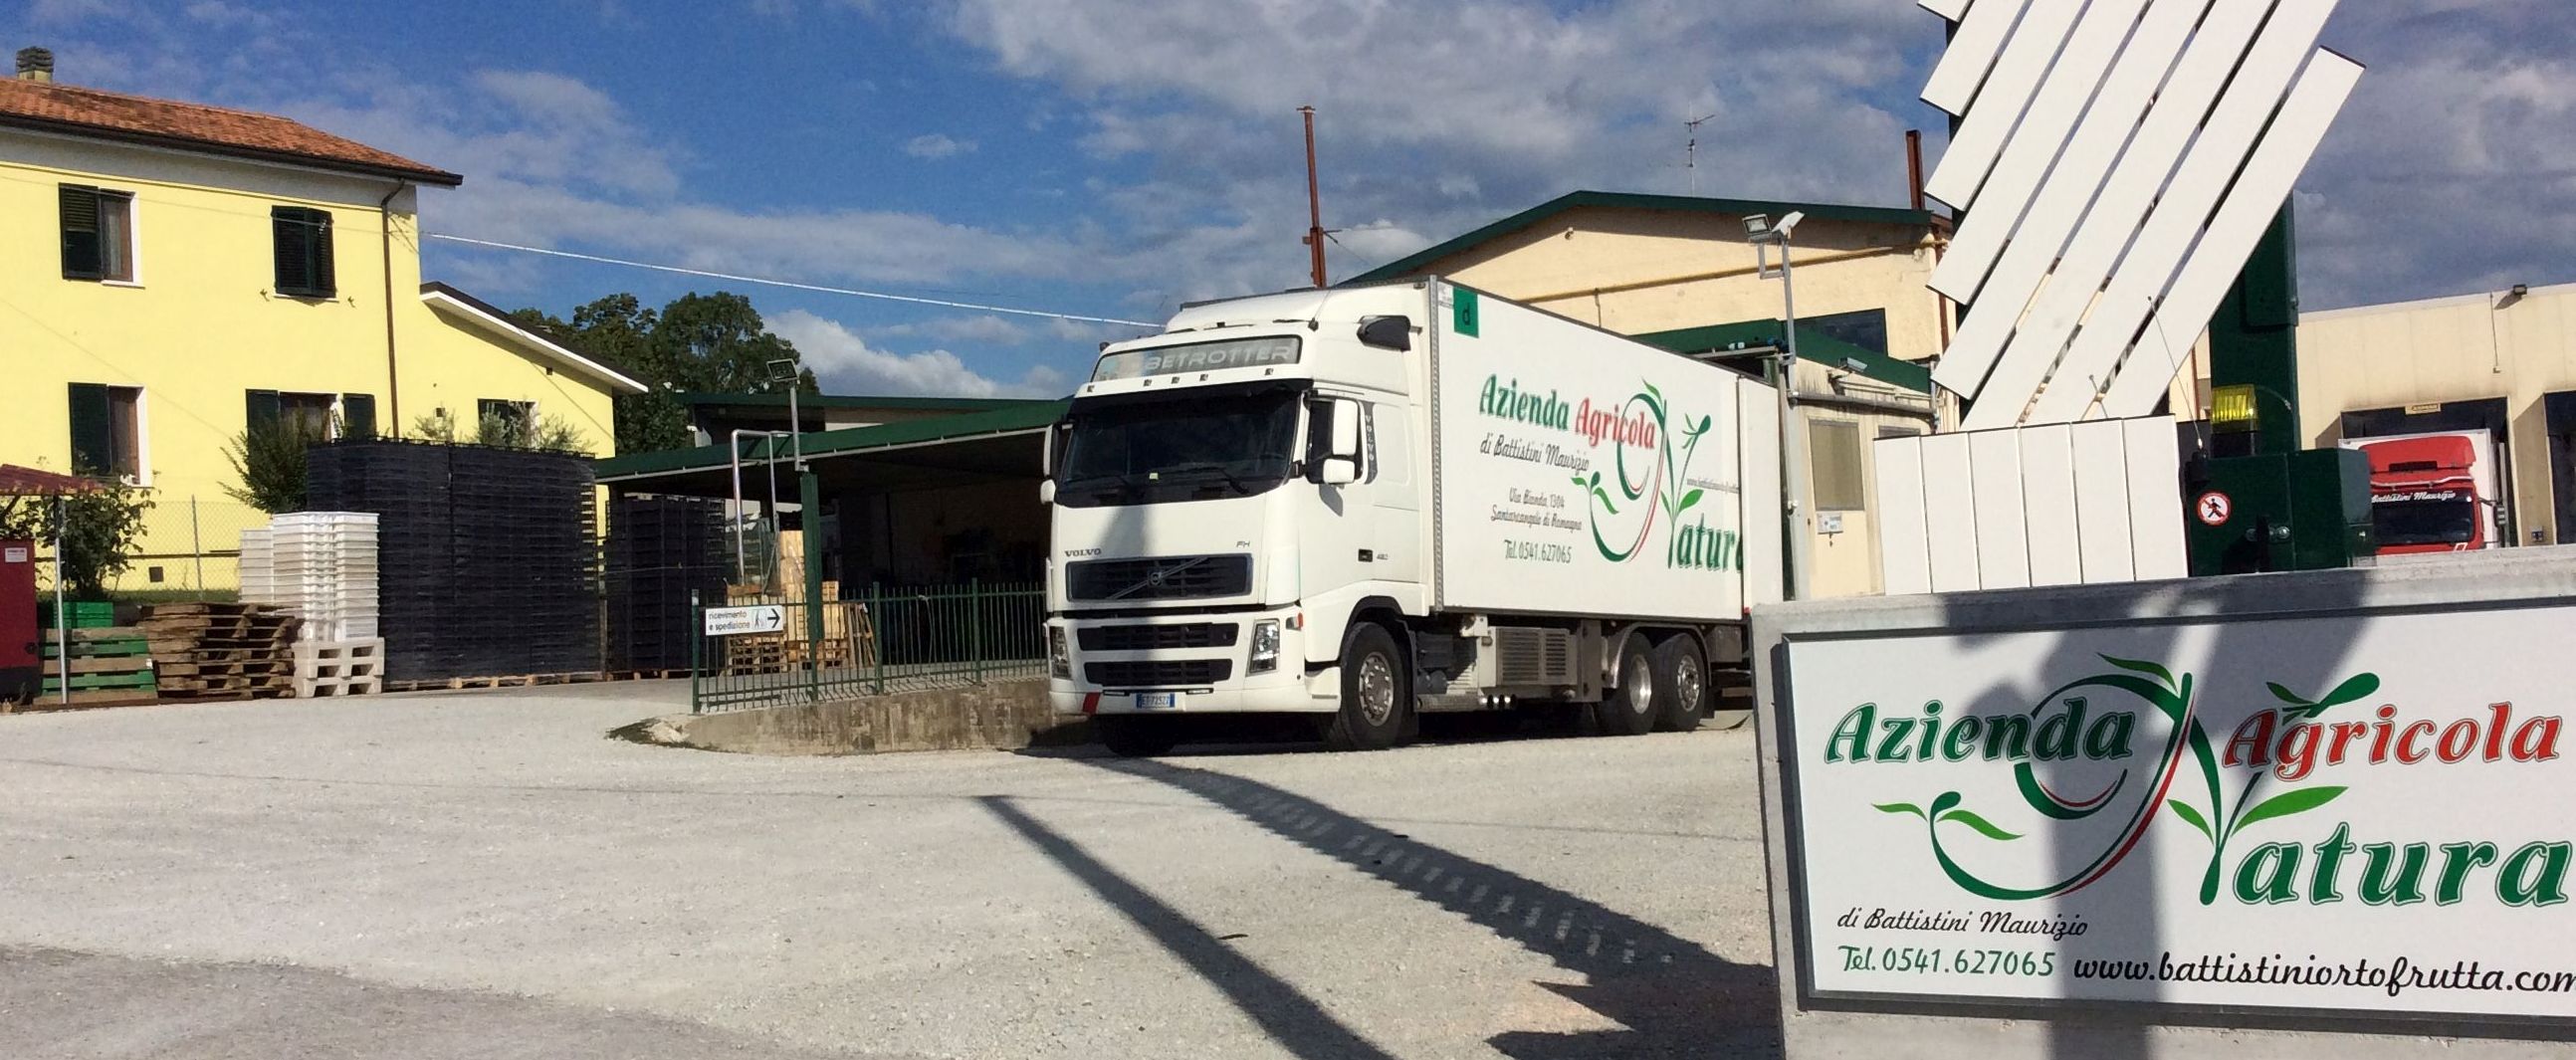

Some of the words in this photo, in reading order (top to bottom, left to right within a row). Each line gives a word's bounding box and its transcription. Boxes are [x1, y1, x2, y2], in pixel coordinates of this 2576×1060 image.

[1461, 302, 1471, 326] d
[1479, 373, 1570, 431] Azienda
[1575, 397, 1655, 450] Agricola
[1480, 432, 1493, 455] di
[1493, 434, 1543, 463] Battistini
[1545, 443, 1590, 476] Maurizio
[1065, 548, 1102, 557] VOLVO
[1825, 696, 2136, 763] Azienda
[2222, 701, 2563, 782] Agricola
[1836, 907, 1862, 928] di
[1864, 908, 1973, 933] Battistini
[1980, 911, 2088, 942] Maurizio
